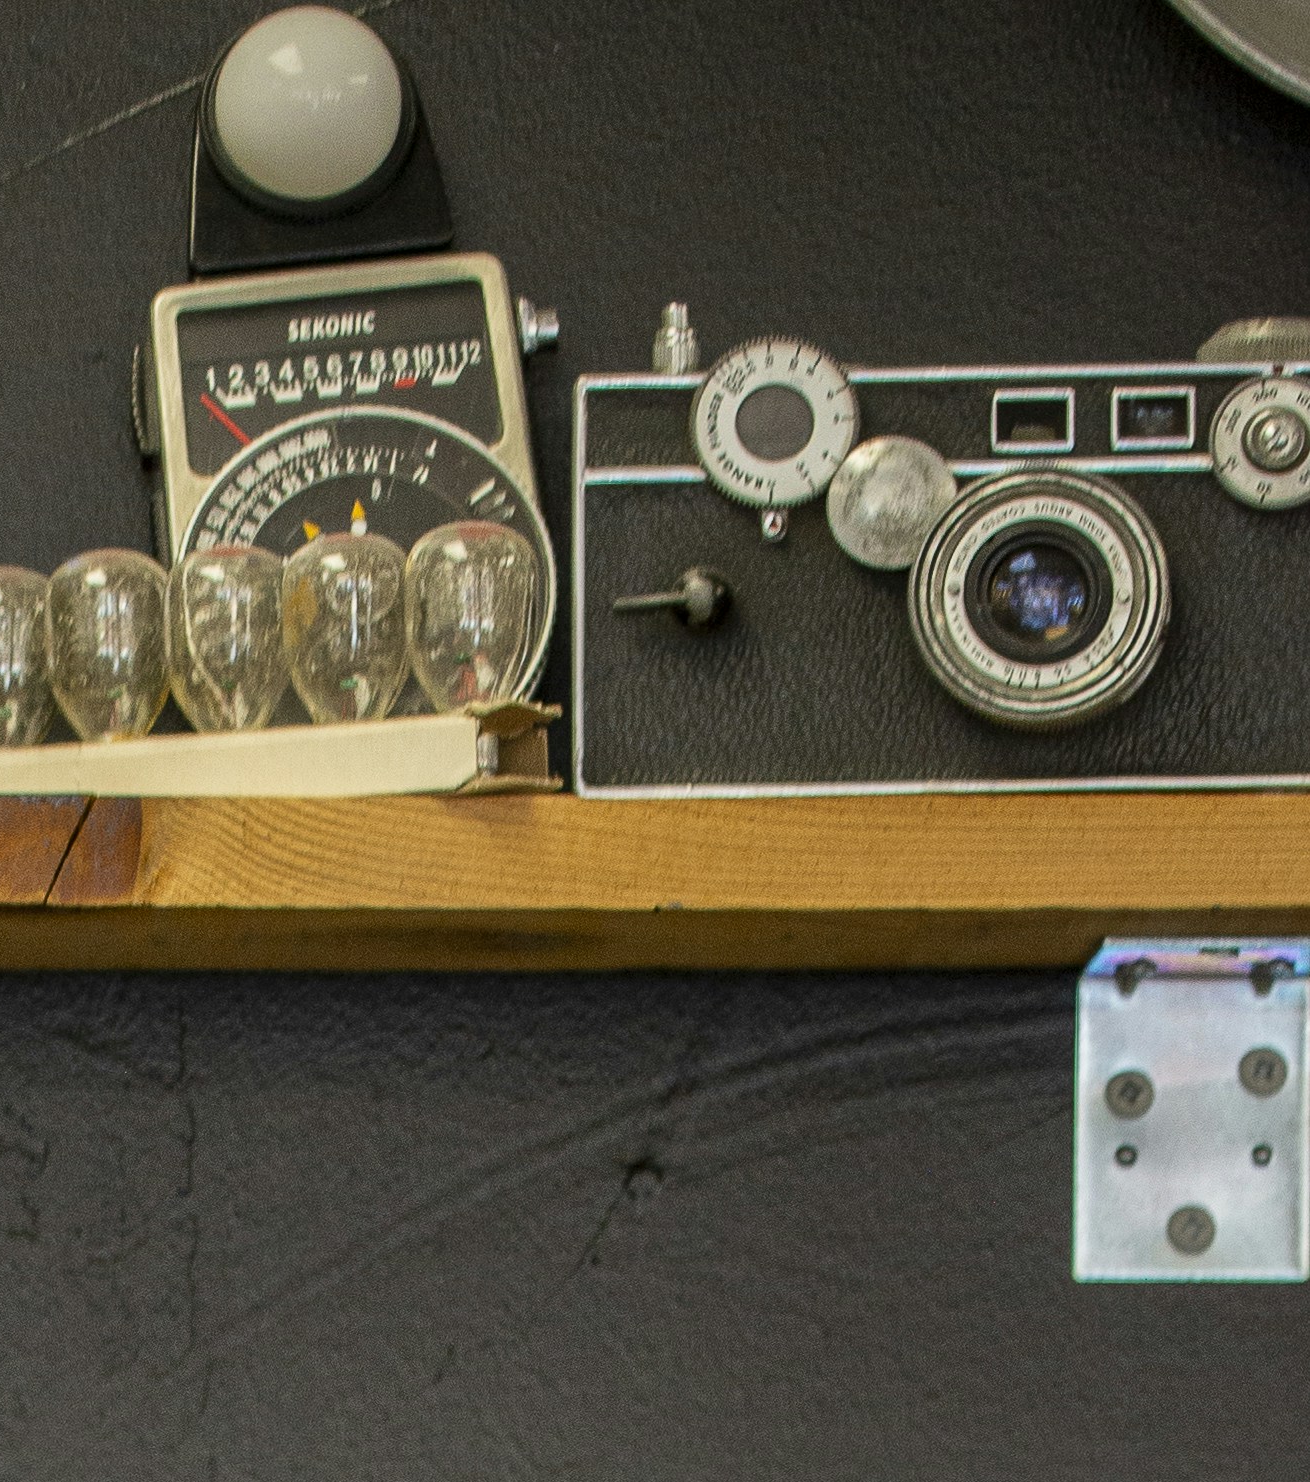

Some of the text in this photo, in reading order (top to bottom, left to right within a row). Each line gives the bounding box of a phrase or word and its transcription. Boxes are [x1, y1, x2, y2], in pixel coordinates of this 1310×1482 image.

[288, 310, 376, 343] SEKONIC
[229, 364, 244, 387] 2
[255, 361, 270, 386] 3
